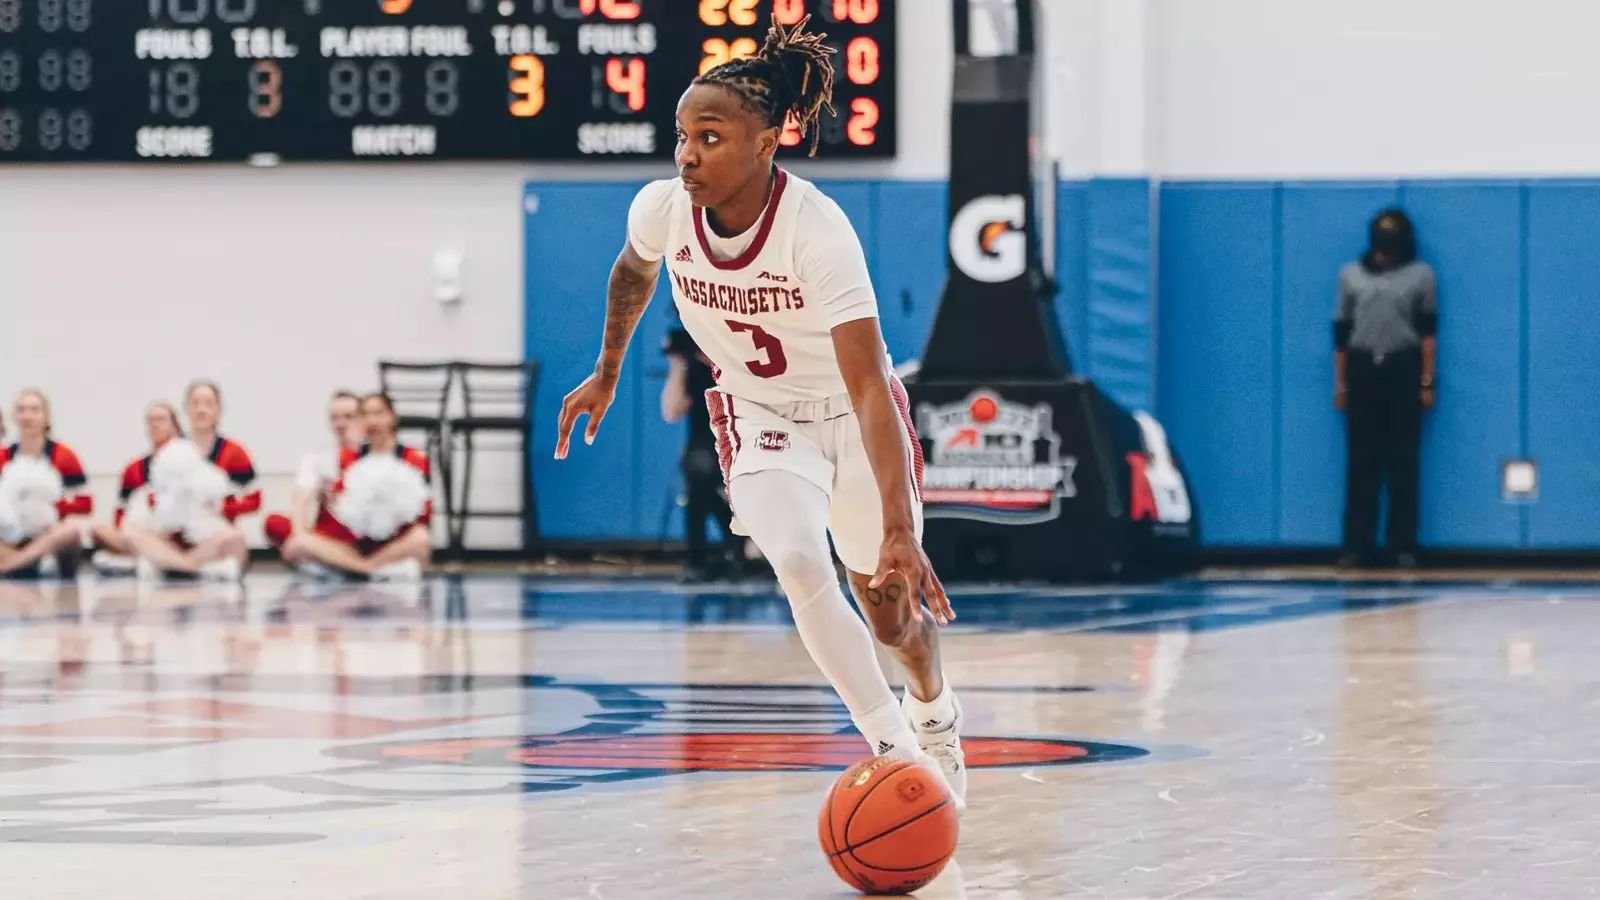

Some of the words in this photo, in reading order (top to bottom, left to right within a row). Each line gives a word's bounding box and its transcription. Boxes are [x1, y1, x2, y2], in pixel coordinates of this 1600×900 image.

[578, 24, 656, 55] FOULS
[509, 55, 545, 117] 3
[577, 123, 656, 154] SCORE
[672, 269, 805, 316] MASSACHUSETTS
[724, 319, 788, 378] 3
